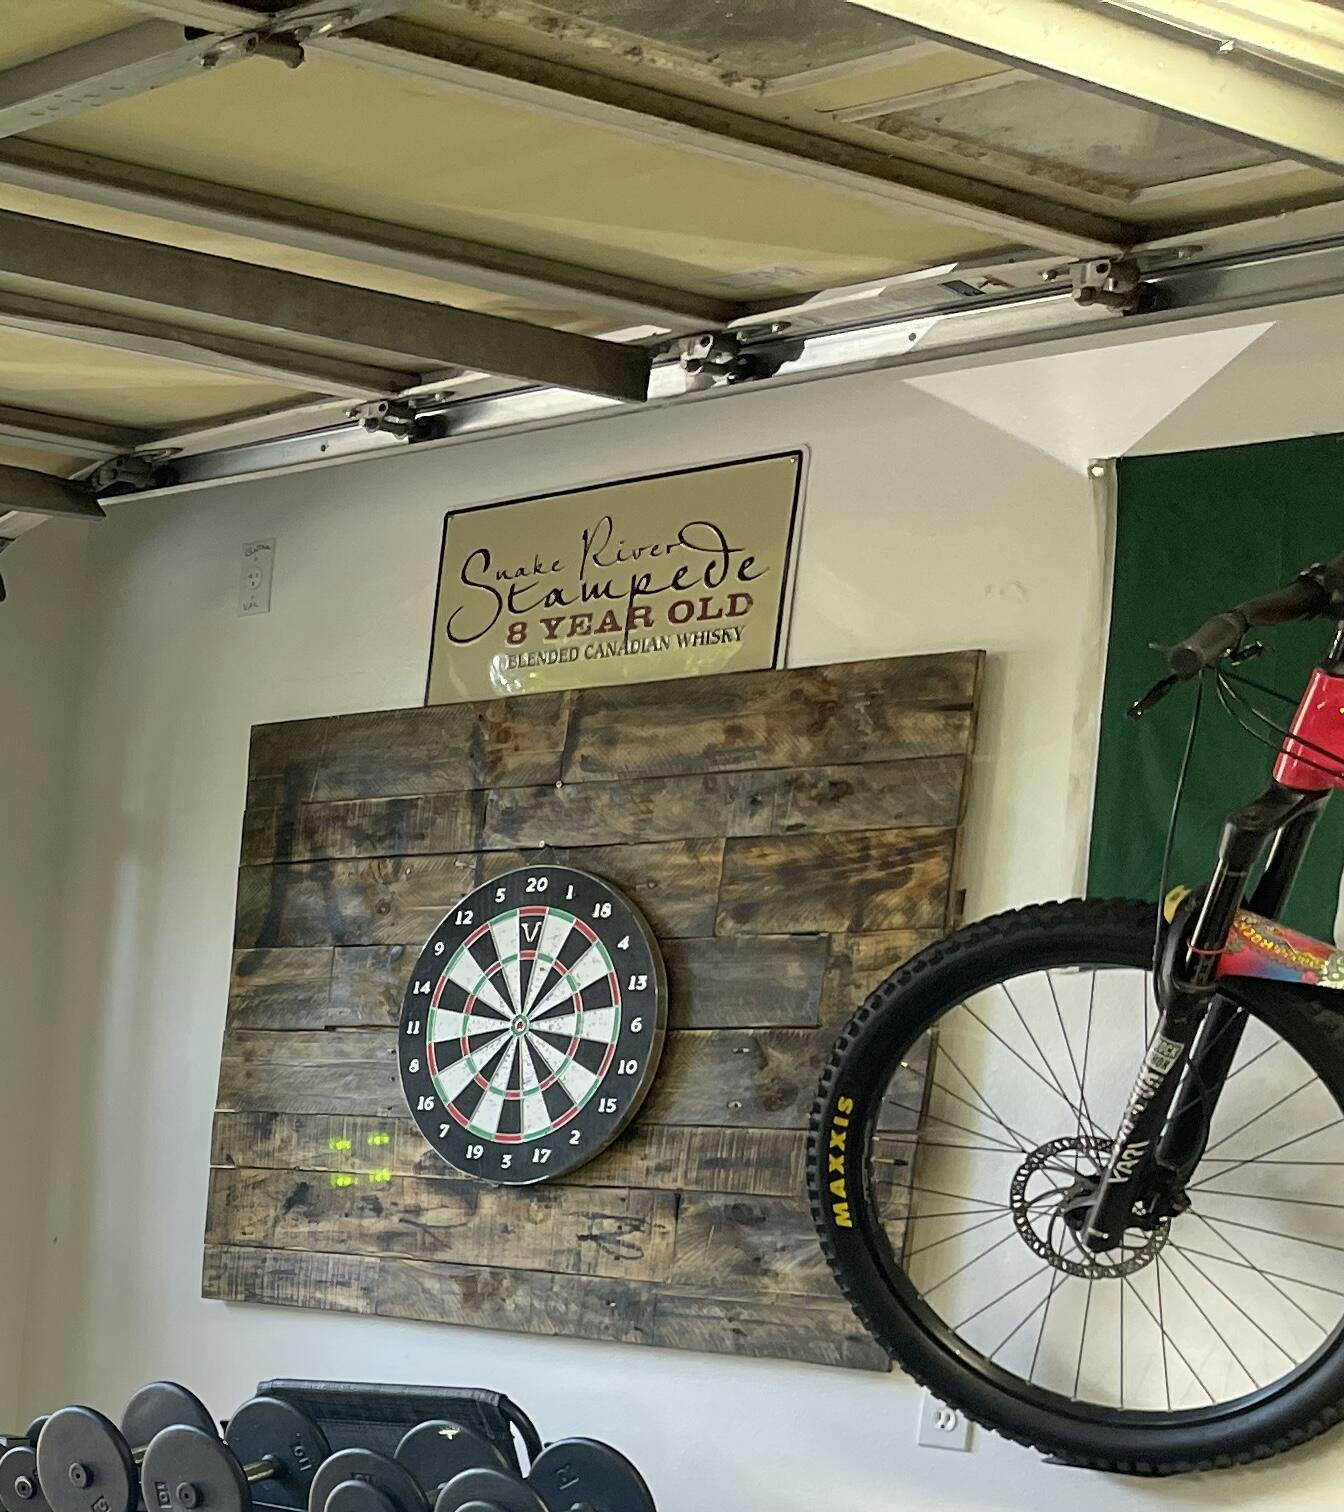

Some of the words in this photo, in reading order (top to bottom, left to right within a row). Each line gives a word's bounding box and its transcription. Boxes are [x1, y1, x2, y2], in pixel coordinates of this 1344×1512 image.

[580, 516, 686, 580] River
[447, 521, 769, 645] Stampede
[506, 622, 527, 645] 8
[543, 606, 654, 640] YEAR
[668, 593, 754, 624] OLD
[508, 647, 579, 669] BLENDED
[585, 634, 671, 659] CANADIAN
[677, 625, 745, 648] WHISKY
[525, 876, 549, 893] 20
[565, 885, 574, 900] 1
[494, 887, 507, 903] 5
[455, 910, 474, 926] 12
[592, 902, 612, 918] 18
[434, 941, 445, 956] 9
[617, 935, 630, 951] 4
[412, 980, 431, 995] 14
[627, 974, 648, 991] 13
[406, 1021, 420, 1035] 11
[630, 1017, 643, 1032] 6
[408, 1059, 420, 1073] 8
[617, 1059, 638, 1075] 10
[416, 1096, 435, 1111] 16
[597, 1097, 618, 1113] 15
[439, 1123, 451, 1138] 7
[568, 1130, 581, 1145] 2
[466, 1145, 484, 1160] 19
[532, 1148, 552, 1164] 17
[500, 1154, 512, 1169] 3
[828, 1095, 854, 1228] MAXXIS
[1108, 1140, 1150, 1183] YARI
